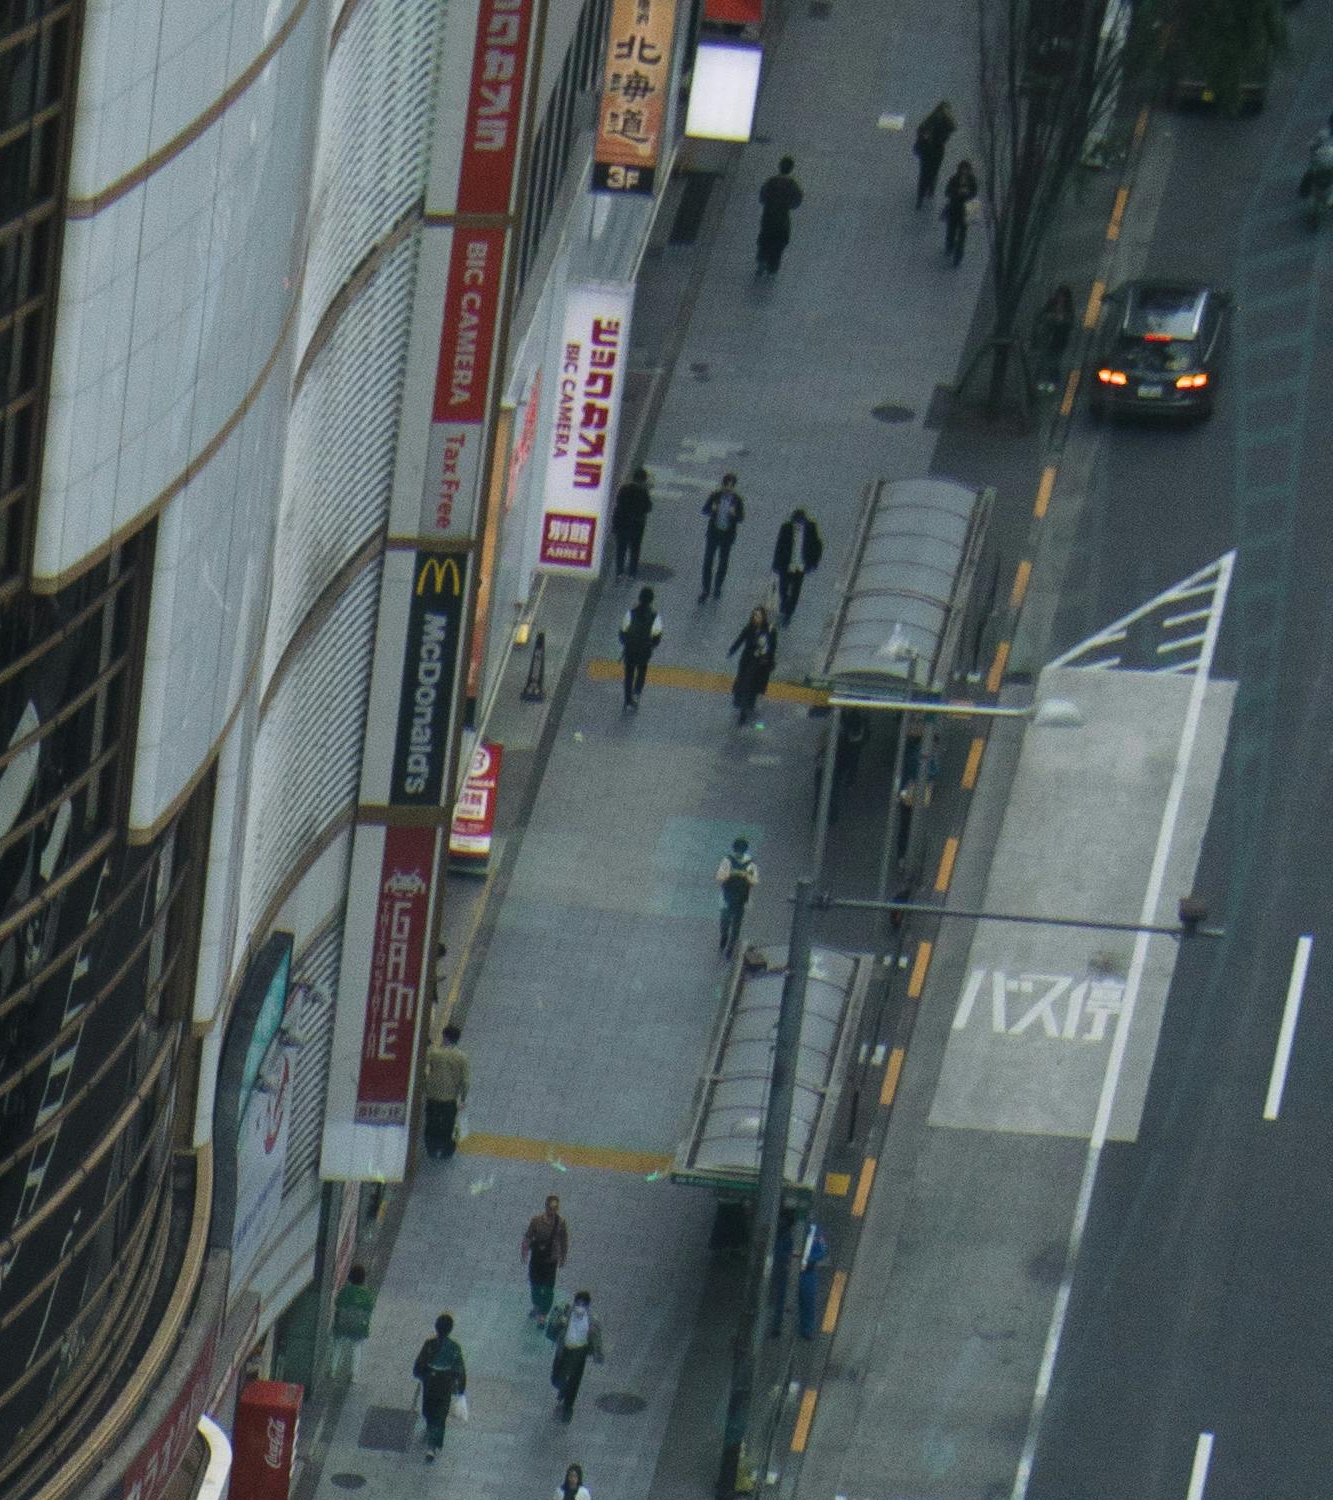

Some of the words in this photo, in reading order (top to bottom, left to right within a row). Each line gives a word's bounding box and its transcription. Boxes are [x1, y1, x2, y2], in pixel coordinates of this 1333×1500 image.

[607, 166, 639, 186] 3F
[463, 242, 488, 285] BIC
[450, 294, 481, 405] CAMERA
[564, 342, 581, 377] BIC
[553, 381, 576, 459] CAMERA
[573, 317, 621, 491] ビックカメラ
[442, 432, 466, 478] Tax
[435, 481, 458, 531] Free
[405, 612, 447, 798] McDonald's
[952, 970, 1129, 1042] バス停
